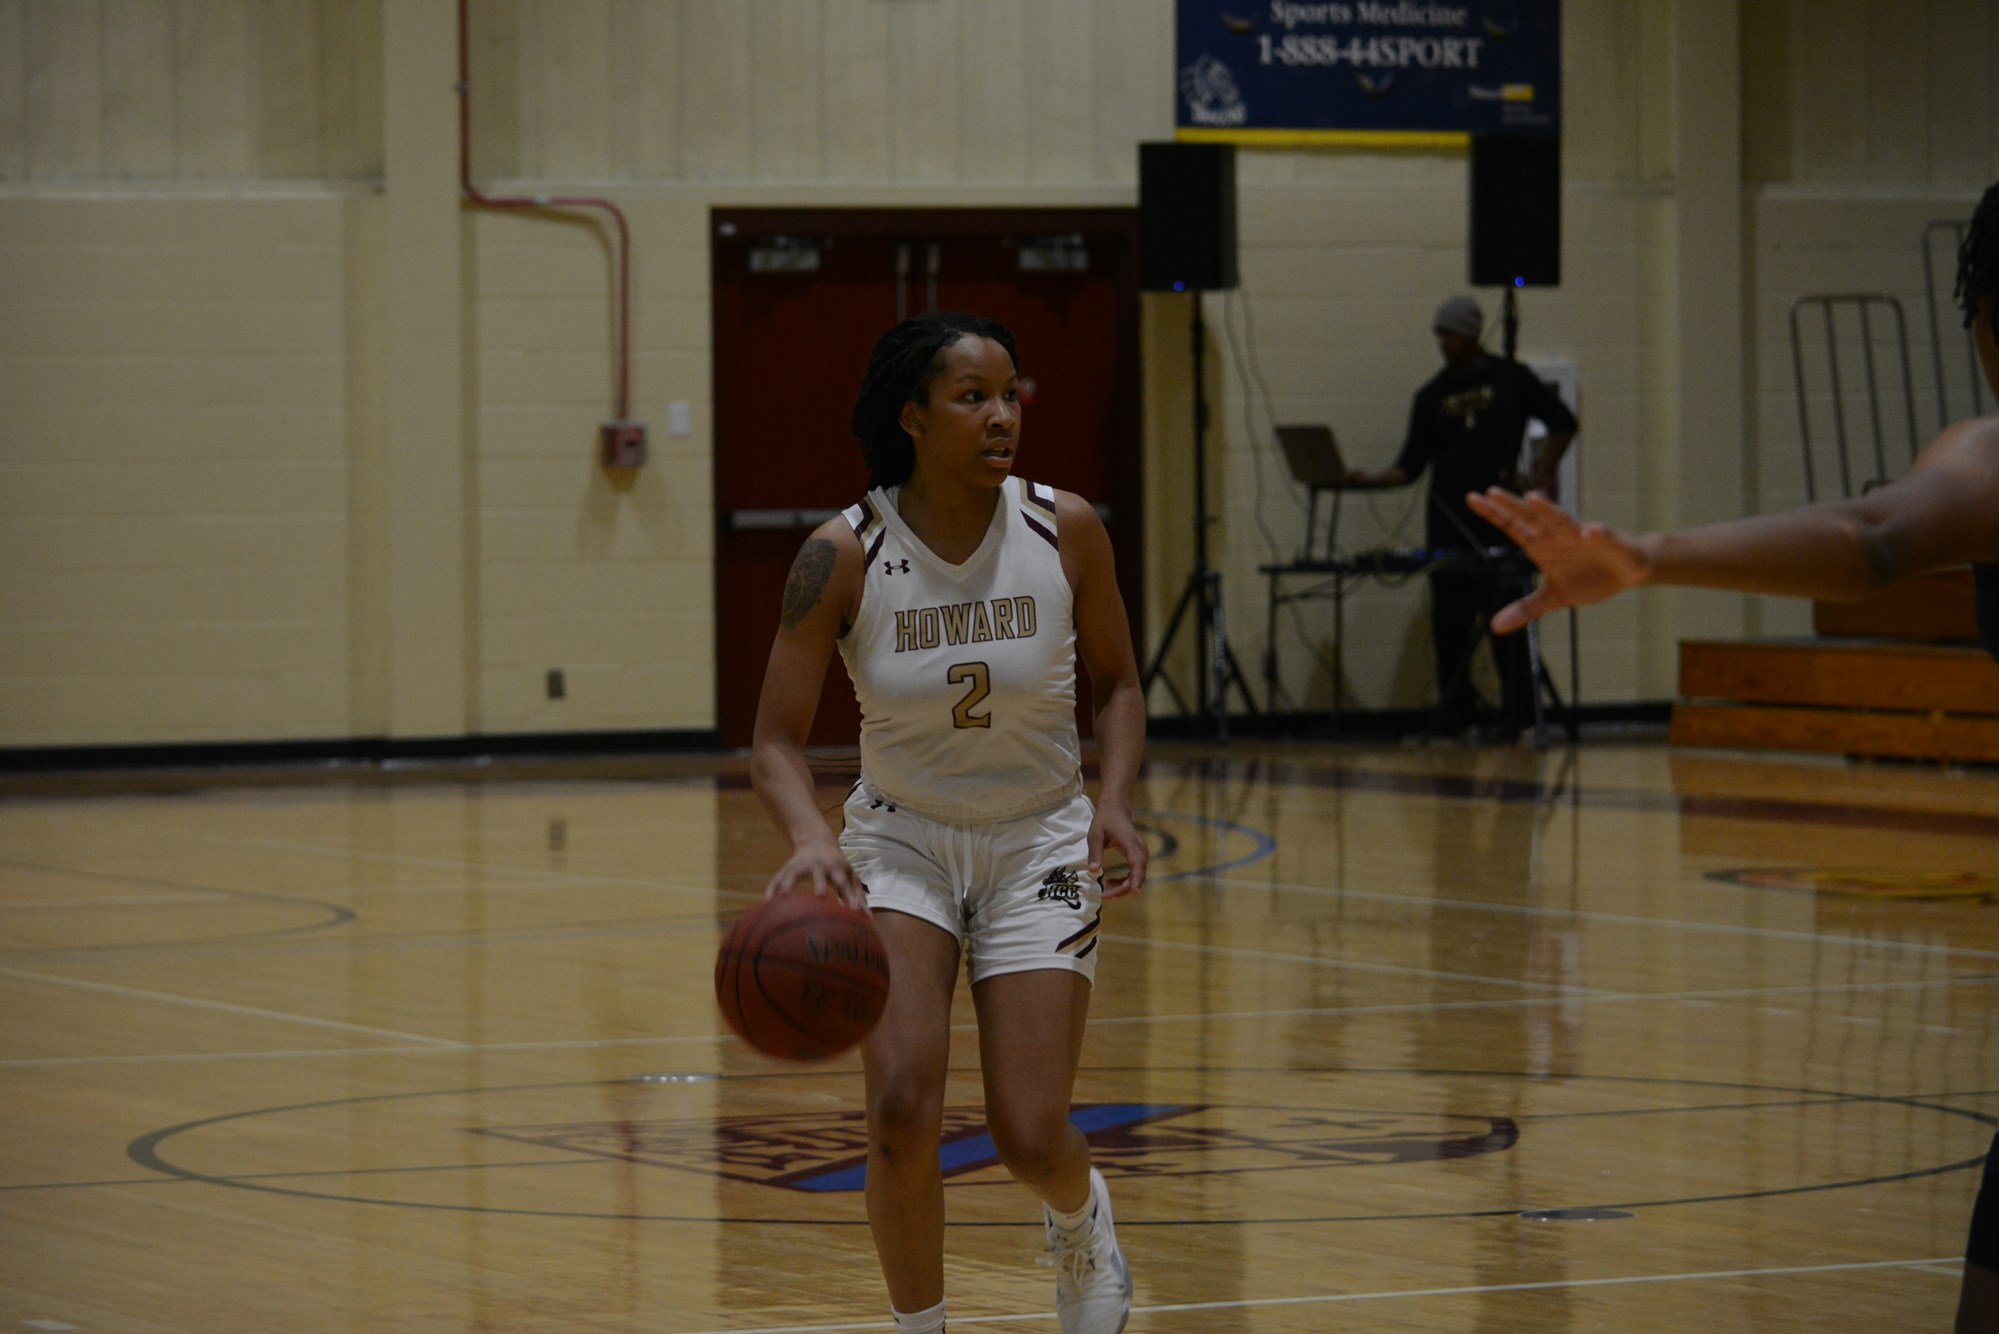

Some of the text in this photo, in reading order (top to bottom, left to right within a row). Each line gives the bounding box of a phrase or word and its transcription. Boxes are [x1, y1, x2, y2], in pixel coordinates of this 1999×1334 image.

[1270, 0, 1468, 30] Sports Medicine
[1257, 33, 1484, 69] 1-888-44SPORT
[894, 595, 1037, 653] HOWARD
[947, 661, 991, 729] 2
